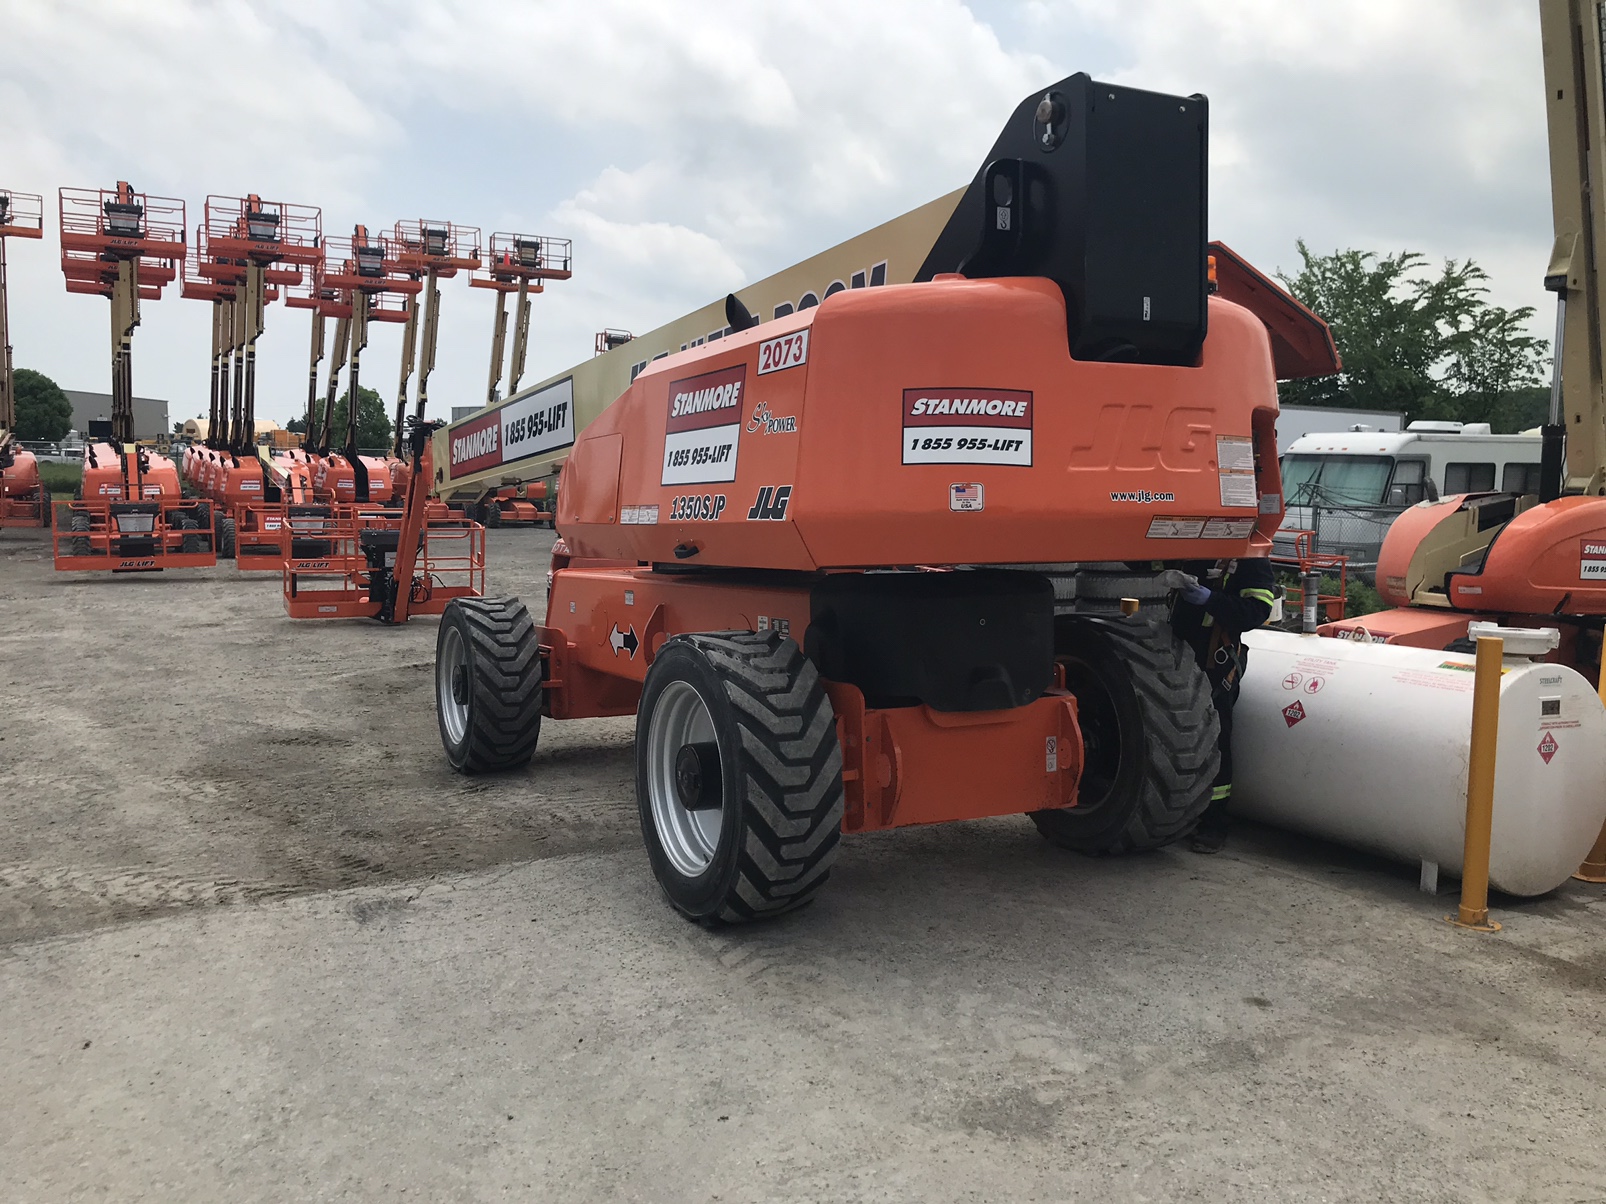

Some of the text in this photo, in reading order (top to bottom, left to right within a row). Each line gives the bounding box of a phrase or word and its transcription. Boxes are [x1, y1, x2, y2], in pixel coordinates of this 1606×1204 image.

[762, 335, 804, 371] 2073
[671, 381, 742, 419] STANMORE
[911, 398, 1028, 417] STANMORE
[505, 401, 568, 447] 1 855 955-LIFT
[1067, 403, 1217, 473] JLG
[452, 424, 498, 465] STANMORE
[667, 443, 732, 467] 1 855 955-LIFT
[911, 438, 1023, 452] 1 855 955-LIFT
[670, 494, 727, 521] 1350SJP
[747, 485, 793, 521] JLG
[1110, 489, 1175, 503] www.jlg.com
[1583, 544, 1606, 554] STAN
